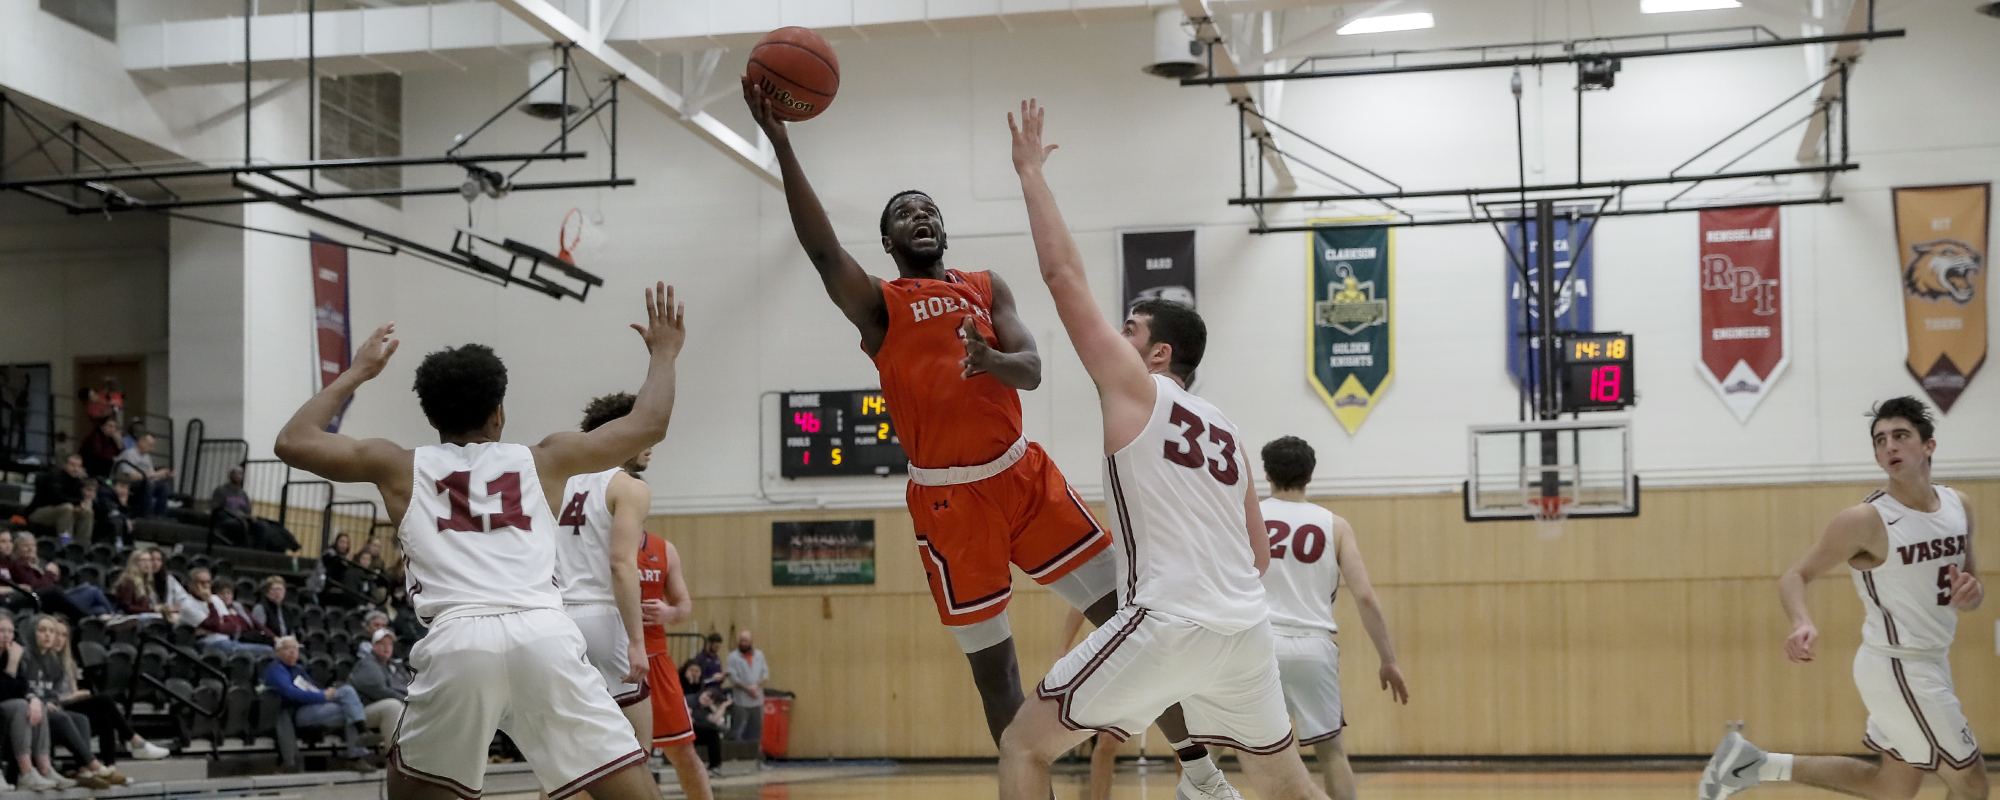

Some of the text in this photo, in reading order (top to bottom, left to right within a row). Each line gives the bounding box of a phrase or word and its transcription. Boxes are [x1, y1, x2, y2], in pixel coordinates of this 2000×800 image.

[760, 75, 815, 111] Wilson
[1706, 228, 1773, 243] RENSSELAER
[1325, 247, 1377, 261] CLARKSON
[1145, 258, 1173, 270] BARD
[1703, 253, 1779, 316] RPI
[1712, 326, 1771, 341] ENGINEERS
[1332, 341, 1371, 354] GOLDEN
[1575, 339, 1626, 359] 14:18
[1330, 354, 1374, 367] KNIGHTS
[1590, 366, 1625, 401] 18
[789, 394, 820, 408] HOME
[794, 412, 821, 433] 46
[878, 423, 889, 440] 2
[787, 437, 811, 447] FOULS
[1163, 401, 1240, 486] 33
[803, 451, 810, 465] 1
[831, 448, 842, 466] 5
[436, 471, 532, 533] 11
[559, 491, 590, 535] 4
[1264, 520, 1326, 564] 20
[1897, 534, 1968, 565] VASSA
[1937, 564, 1957, 606] 5
